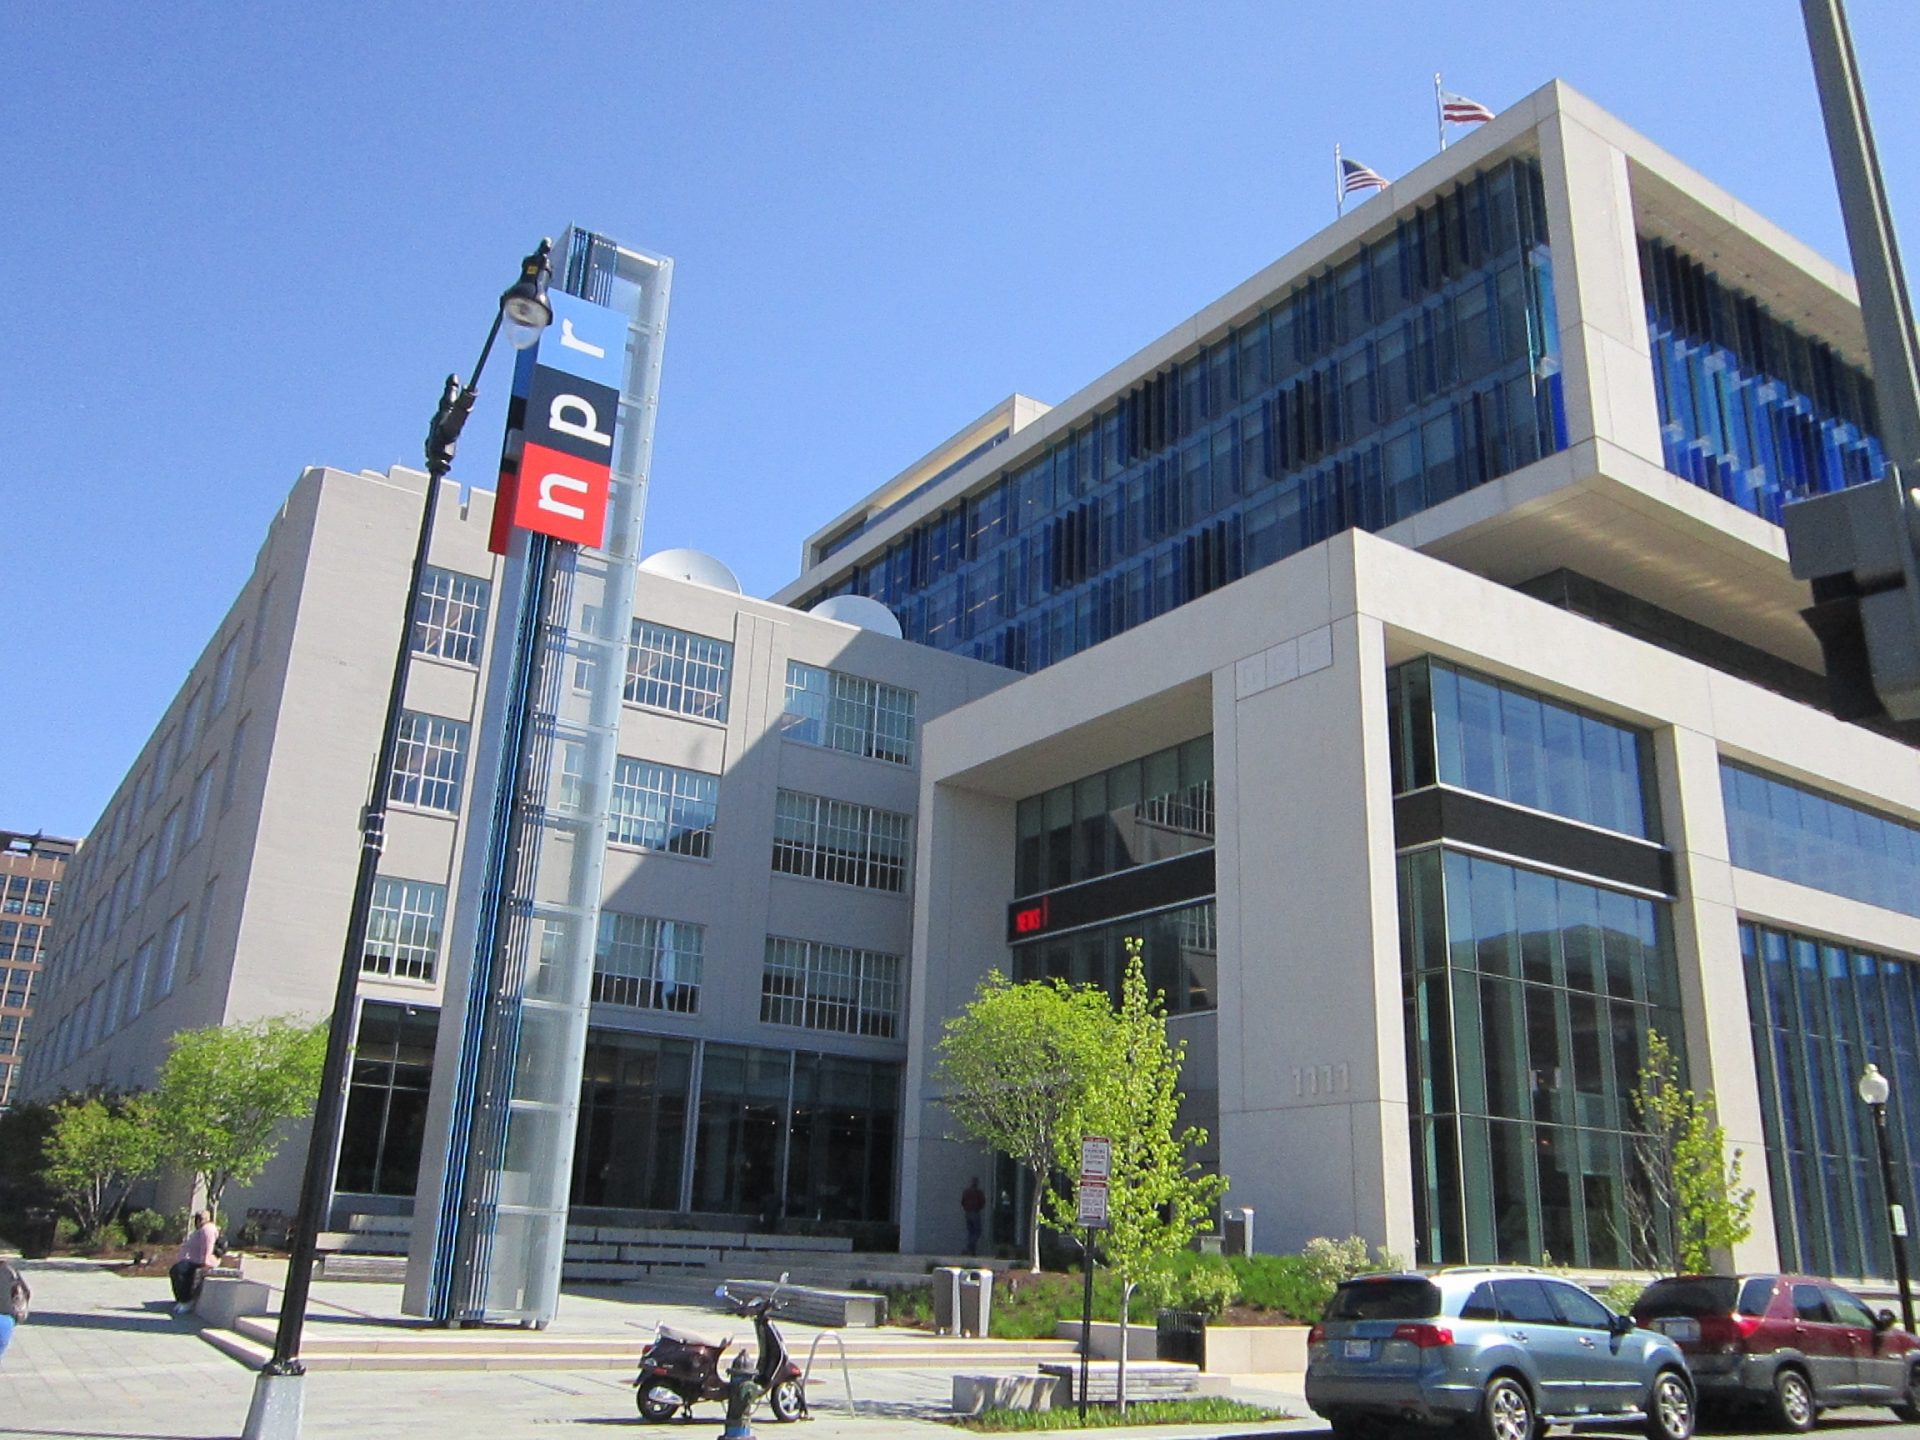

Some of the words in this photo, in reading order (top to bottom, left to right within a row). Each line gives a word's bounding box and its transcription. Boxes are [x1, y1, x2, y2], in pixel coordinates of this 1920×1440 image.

[538, 318, 611, 520] npr
[1016, 908, 1041, 932] NEWS
[1289, 1062, 1351, 1096] 1111
